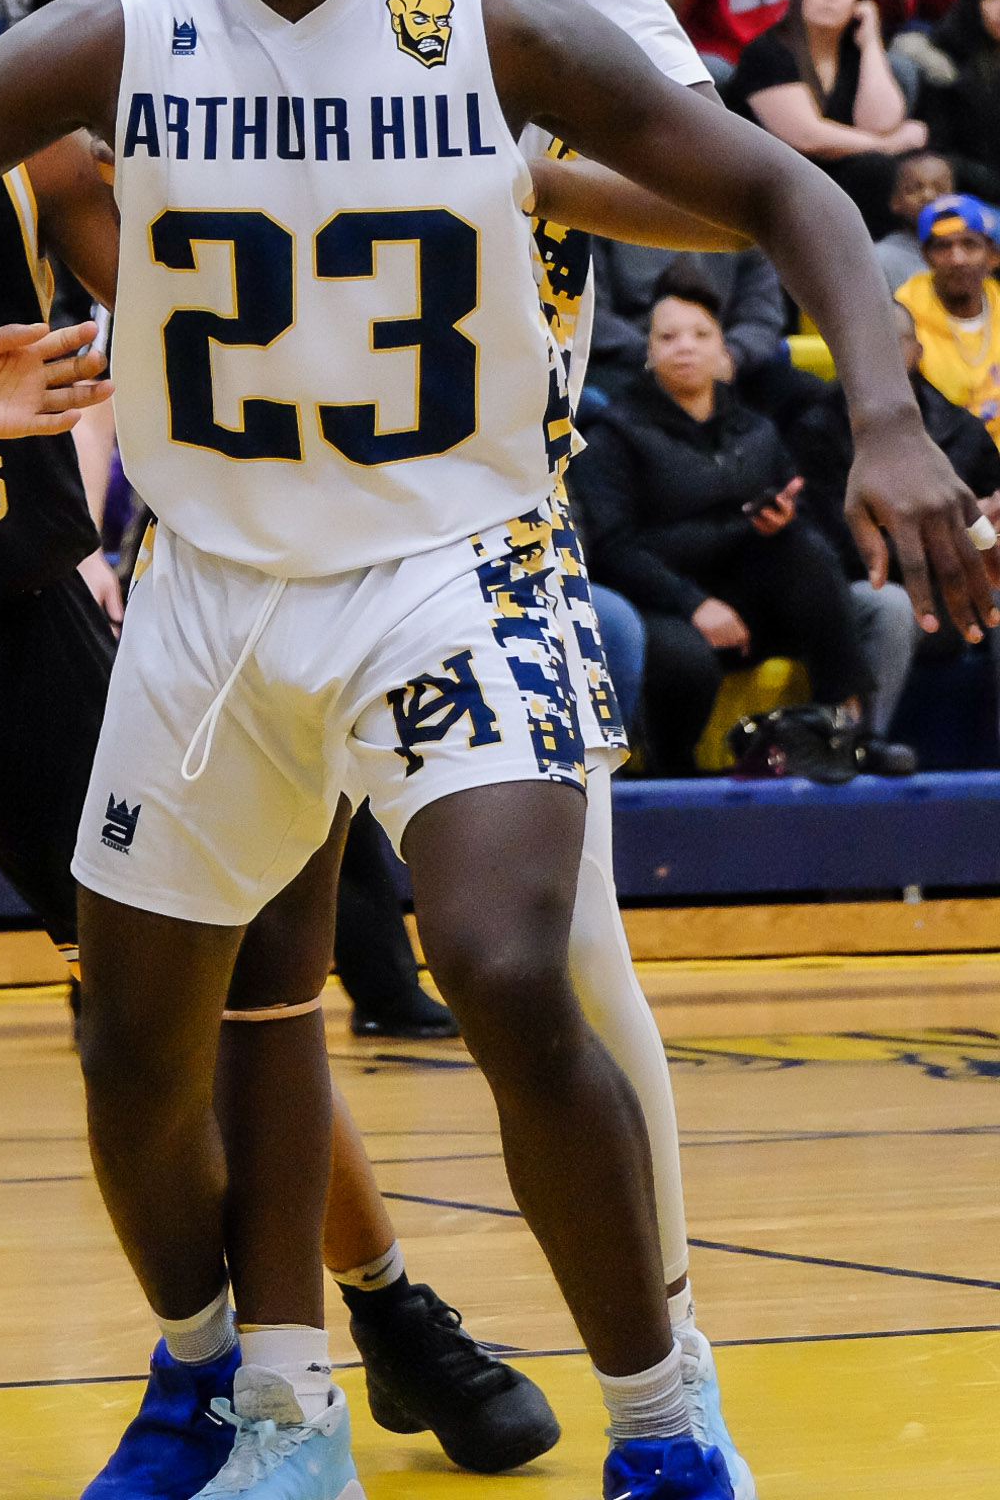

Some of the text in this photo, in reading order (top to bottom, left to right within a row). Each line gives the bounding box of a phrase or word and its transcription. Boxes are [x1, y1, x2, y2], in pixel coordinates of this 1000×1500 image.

[123, 92, 497, 161] ARTHUR HILL
[148, 206, 482, 468] 23
